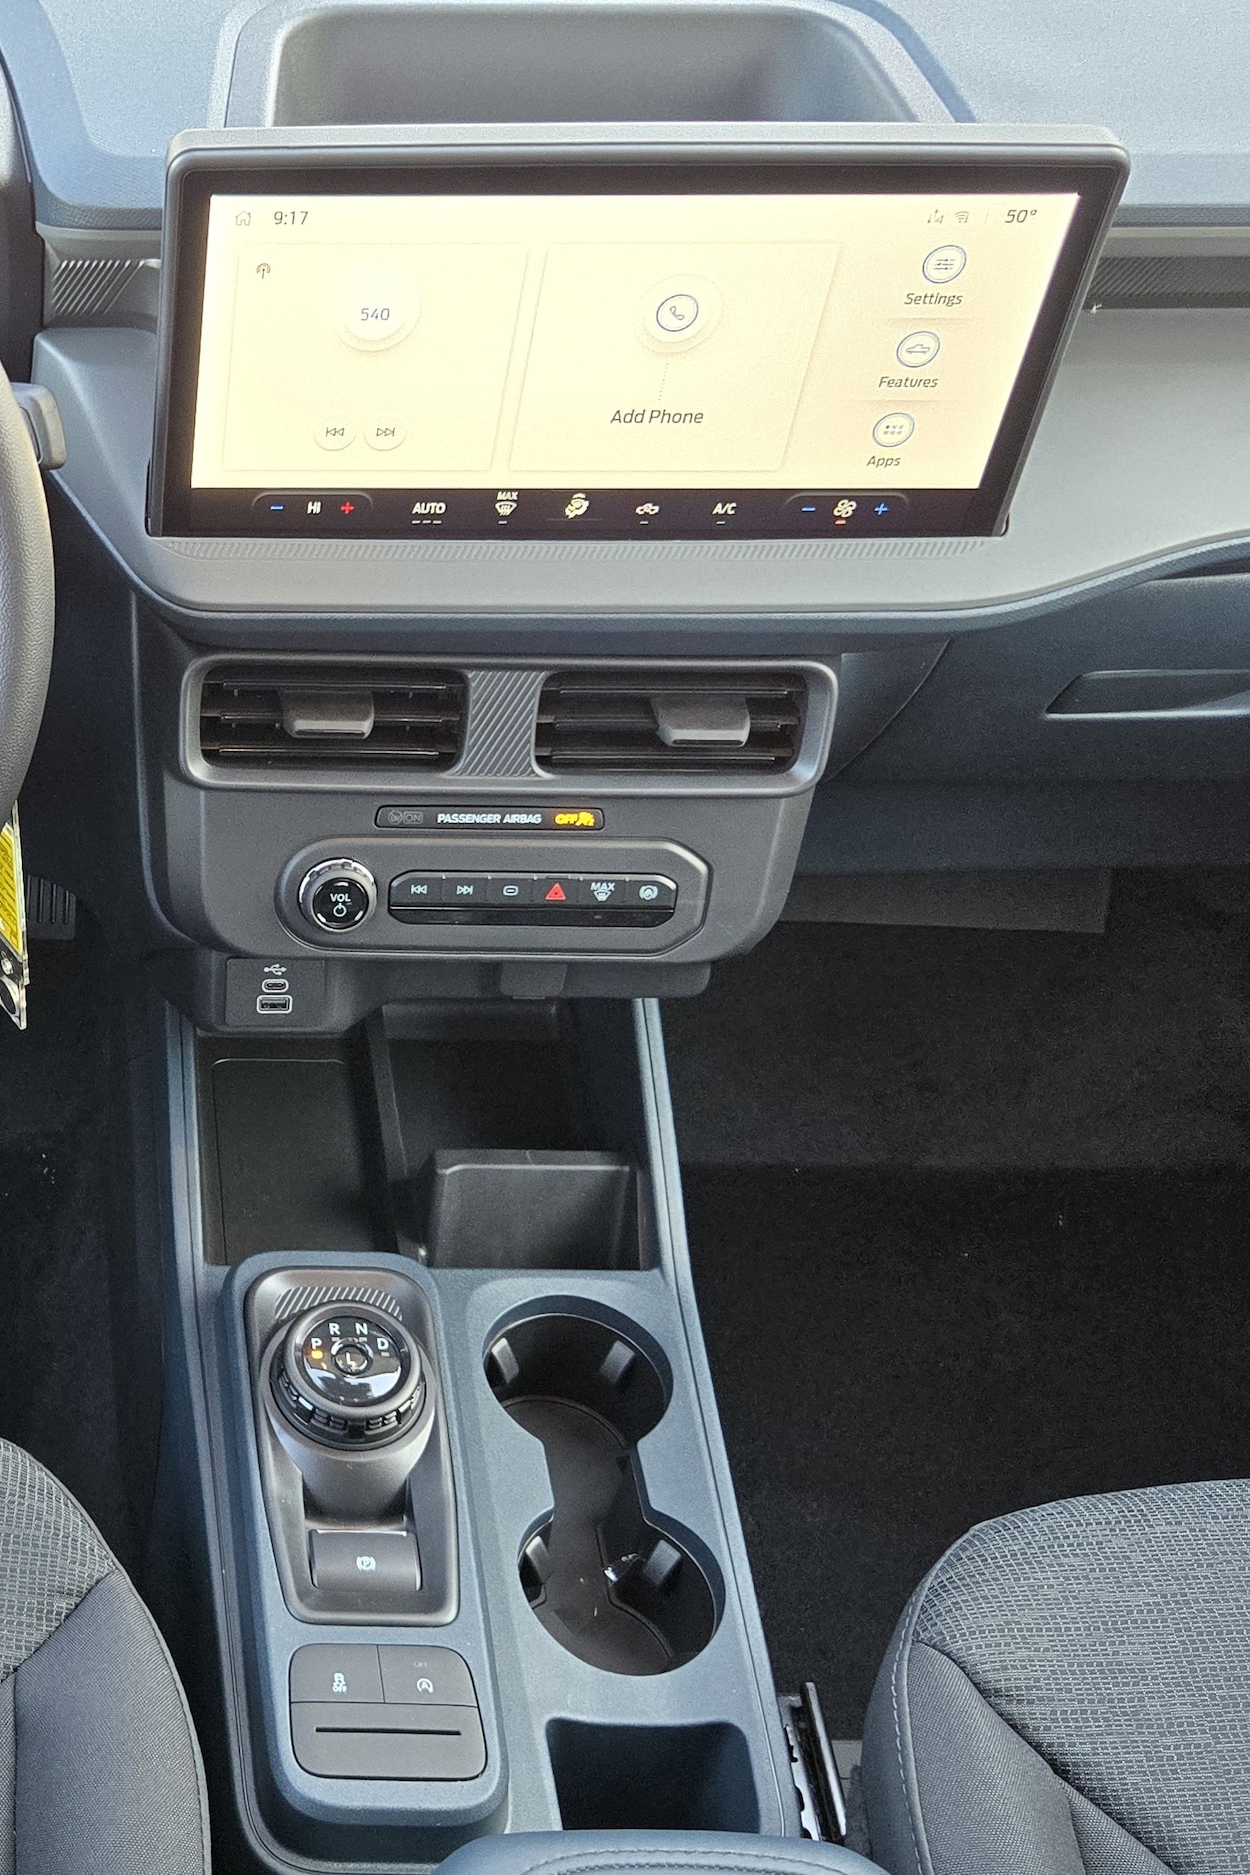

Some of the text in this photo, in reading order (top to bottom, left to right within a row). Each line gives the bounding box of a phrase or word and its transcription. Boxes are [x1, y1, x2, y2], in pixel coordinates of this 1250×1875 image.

[273, 211, 308, 225] 9:17
[1004, 209, 1037, 224] 50°
[904, 292, 963, 307] Settings
[360, 307, 390, 321] 540
[878, 375, 938, 389] Features
[610, 409, 704, 425] Add Phone
[866, 454, 901, 468] Apps
[496, 491, 518, 500] MAX
[307, 502, 321, 514] HI
[412, 502, 446, 514] AUTO
[712, 503, 736, 516] A/C
[437, 813, 542, 824] PASSENGER AIRBAG
[590, 882, 615, 891] MAX
[330, 893, 351, 902] VOL
[329, 1323, 340, 1335] R
[356, 1323, 368, 1335] N
[311, 1338, 322, 1350] P
[378, 1338, 390, 1350] D
